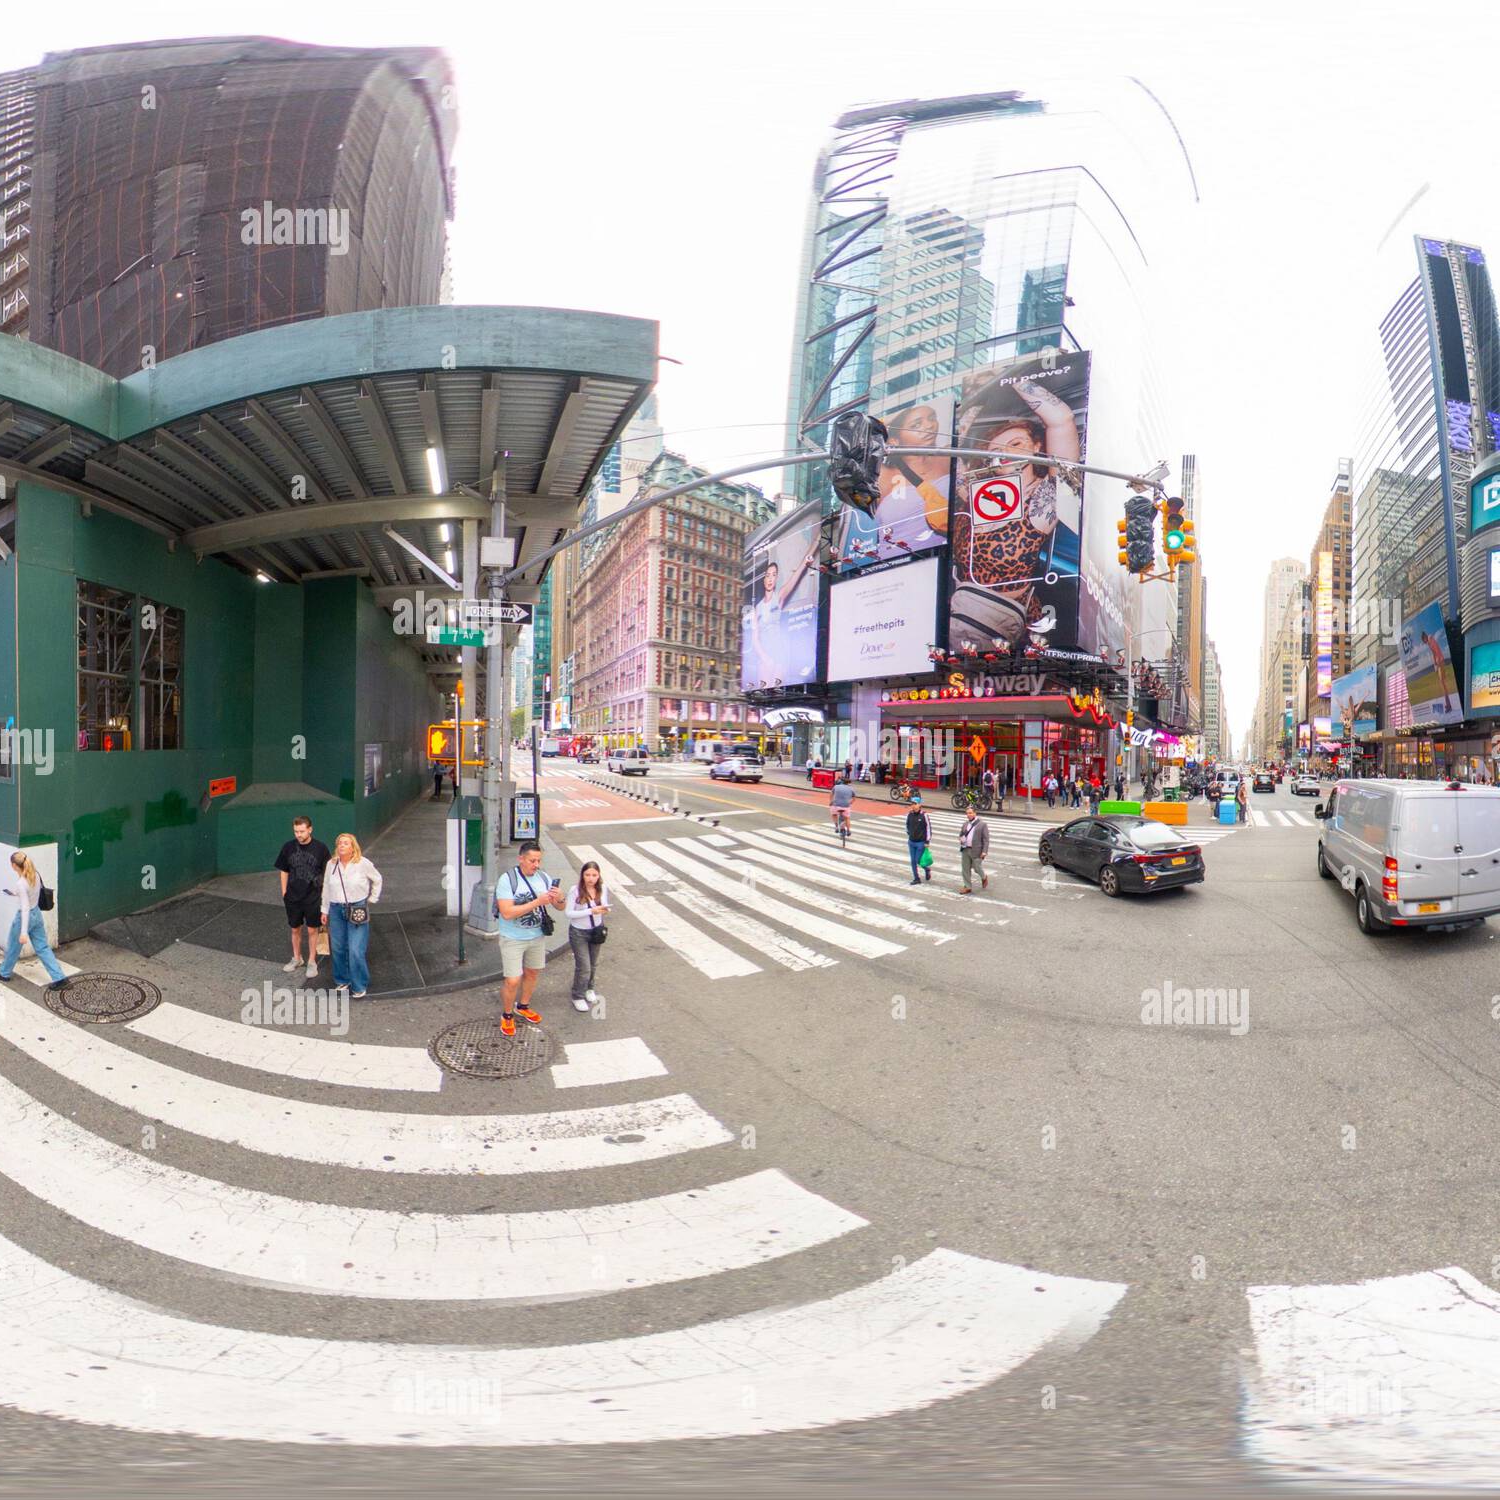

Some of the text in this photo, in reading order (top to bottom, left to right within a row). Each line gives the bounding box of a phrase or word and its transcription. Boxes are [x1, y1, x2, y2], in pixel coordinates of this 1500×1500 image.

[1020, 366, 1071, 384] peeve?
[471, 607, 523, 618] ONE WAY
[854, 617, 906, 635] #freethepits
[452, 629, 458, 643] 7
[948, 671, 1047, 696] Subway
